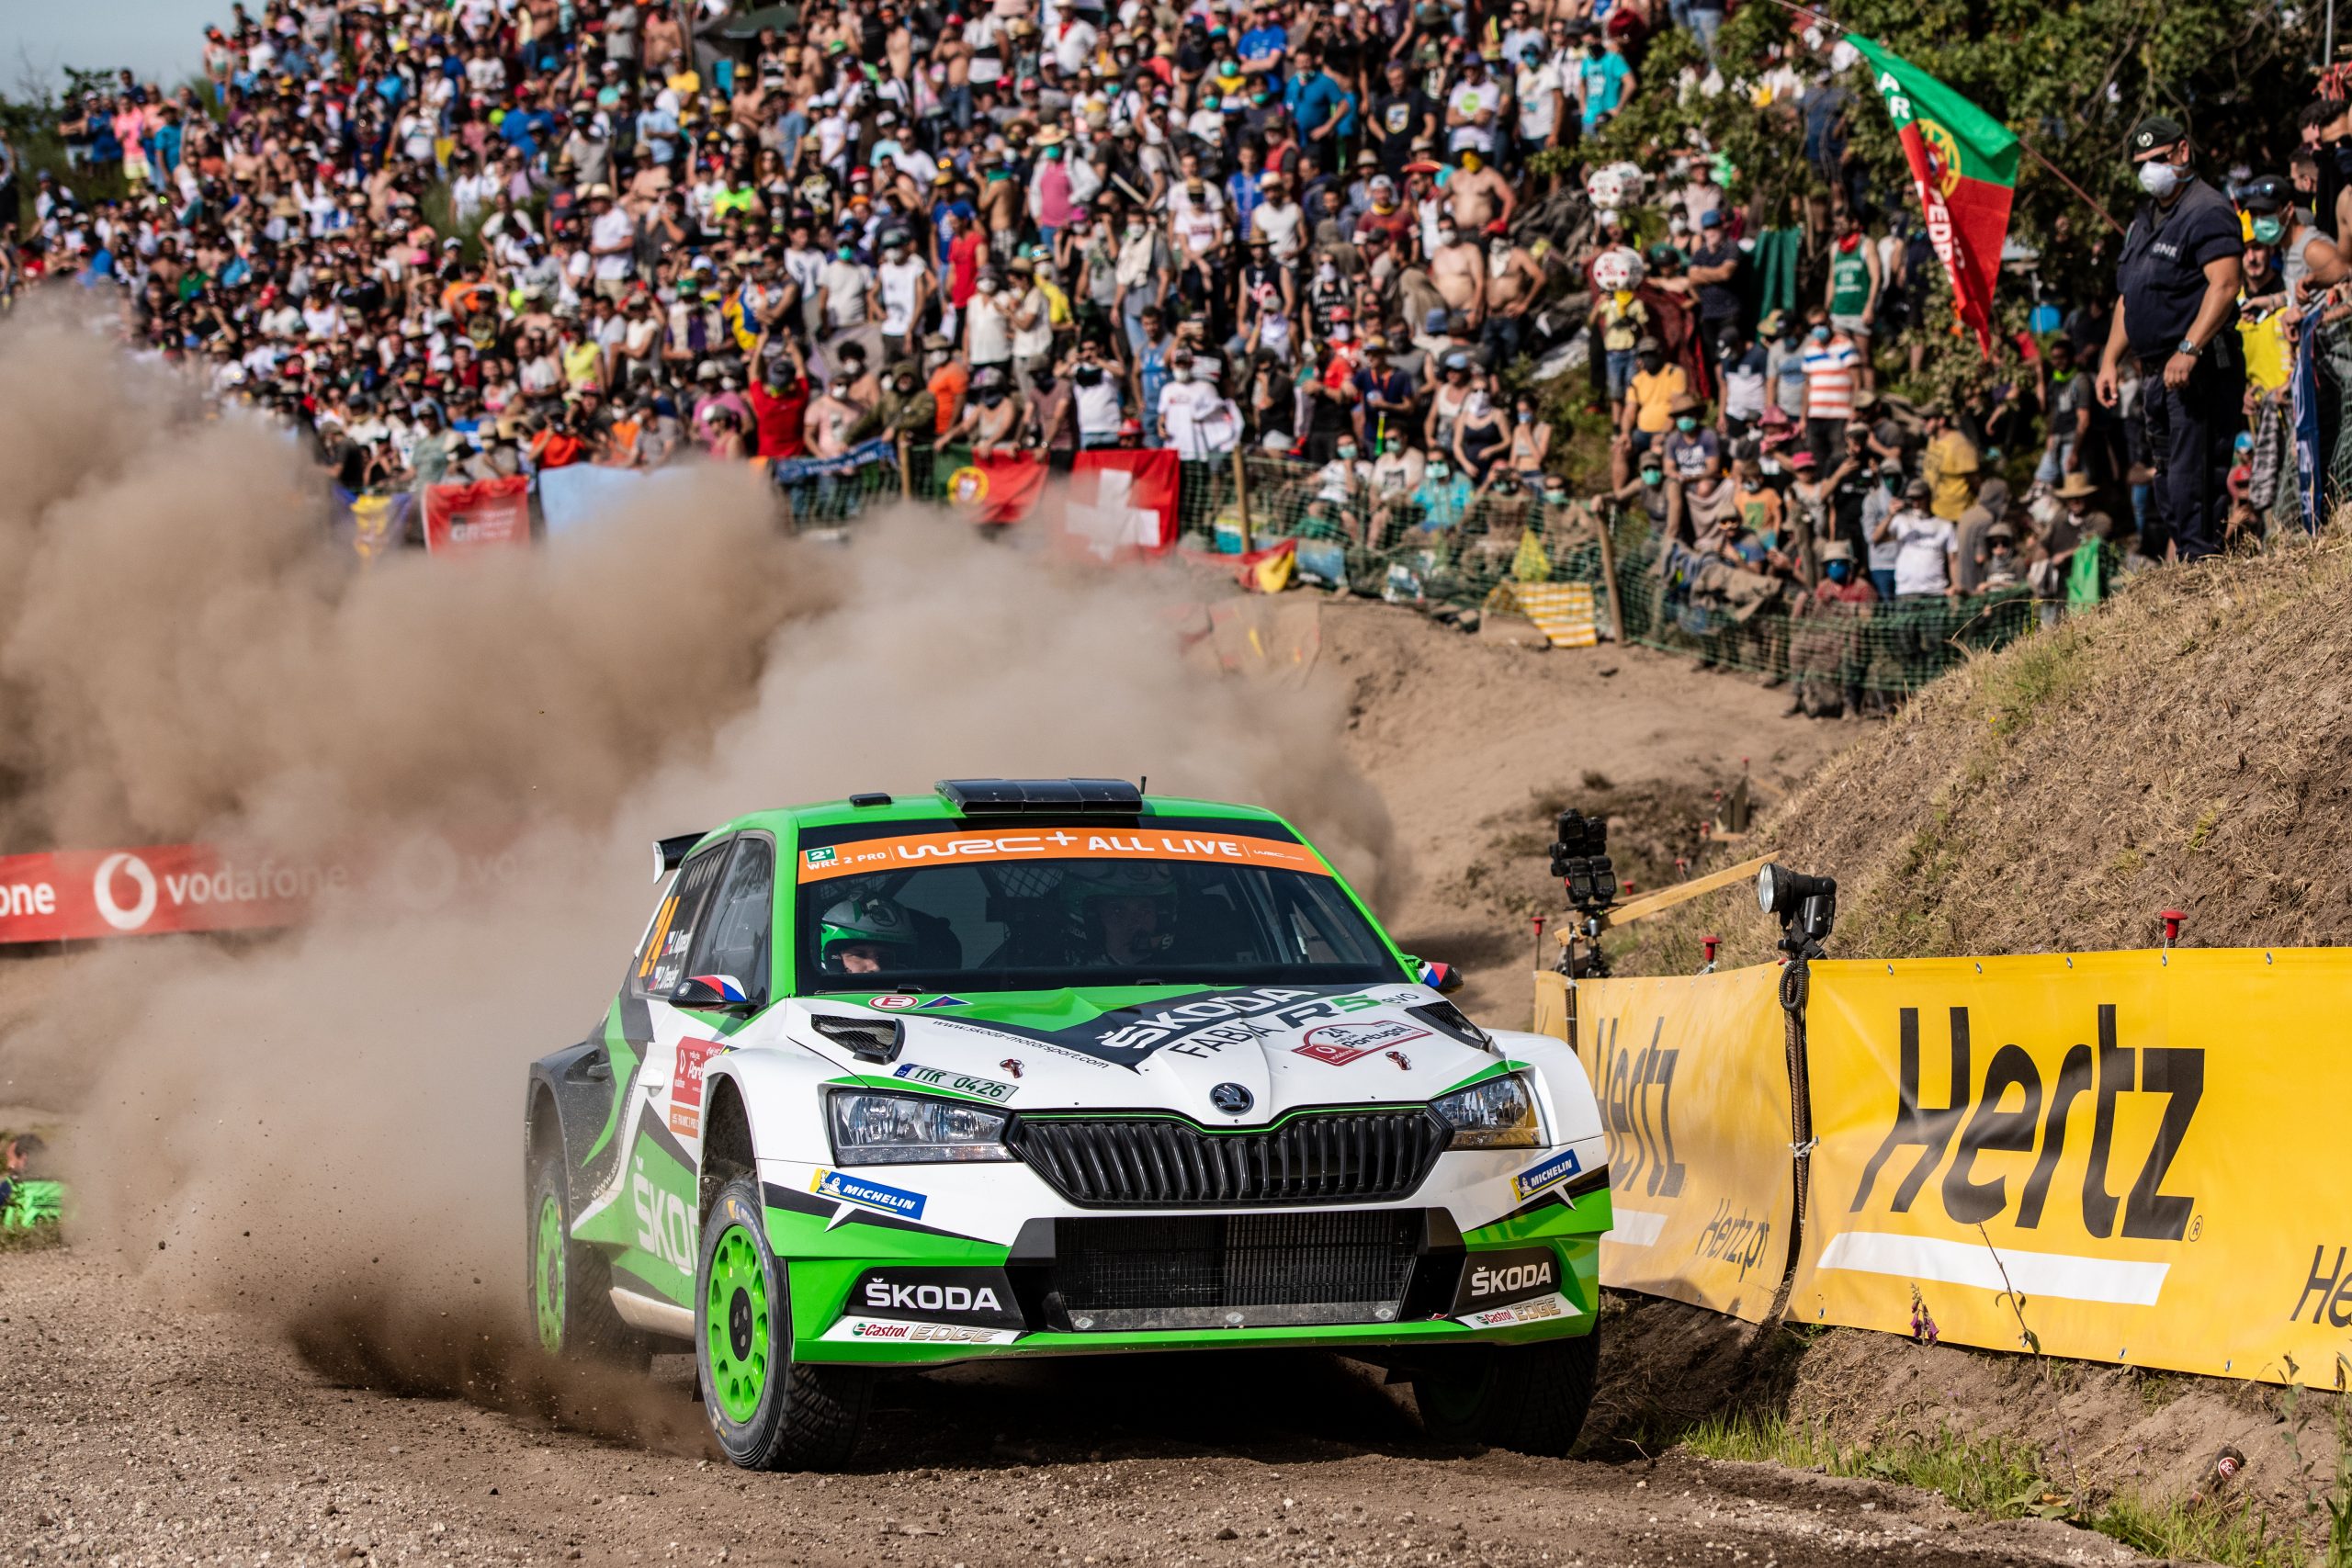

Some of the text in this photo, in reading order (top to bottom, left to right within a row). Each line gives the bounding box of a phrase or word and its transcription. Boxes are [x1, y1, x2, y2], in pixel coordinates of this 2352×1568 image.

[807, 852, 887, 871] WRC 2 PRO
[1088, 836, 1155, 852] ALL
[1161, 838, 1243, 857] LIVE
[165, 861, 349, 905] vodafone
[1095, 988, 1318, 1049] ŠKODA
[1168, 992, 1420, 1058] FABIA R5 evo
[1317, 1027, 1351, 1039] 24
[933, 1021, 1110, 1069] www.skoda-motorsport.com
[1341, 1026, 1412, 1048] Portugal
[953, 1077, 1007, 1098] 0426
[1595, 1016, 1686, 1198] Hertz
[1849, 1004, 2205, 1241] Hertz
[1530, 1158, 1573, 1188] MICHELIN
[842, 1184, 916, 1210] MICHELIN
[1471, 1261, 1552, 1297] ŠKODA
[865, 1278, 1002, 1312] ŠKODA
[1484, 1297, 1561, 1325] Castrol EDGE
[865, 1323, 1002, 1343] Castrol EDGE
